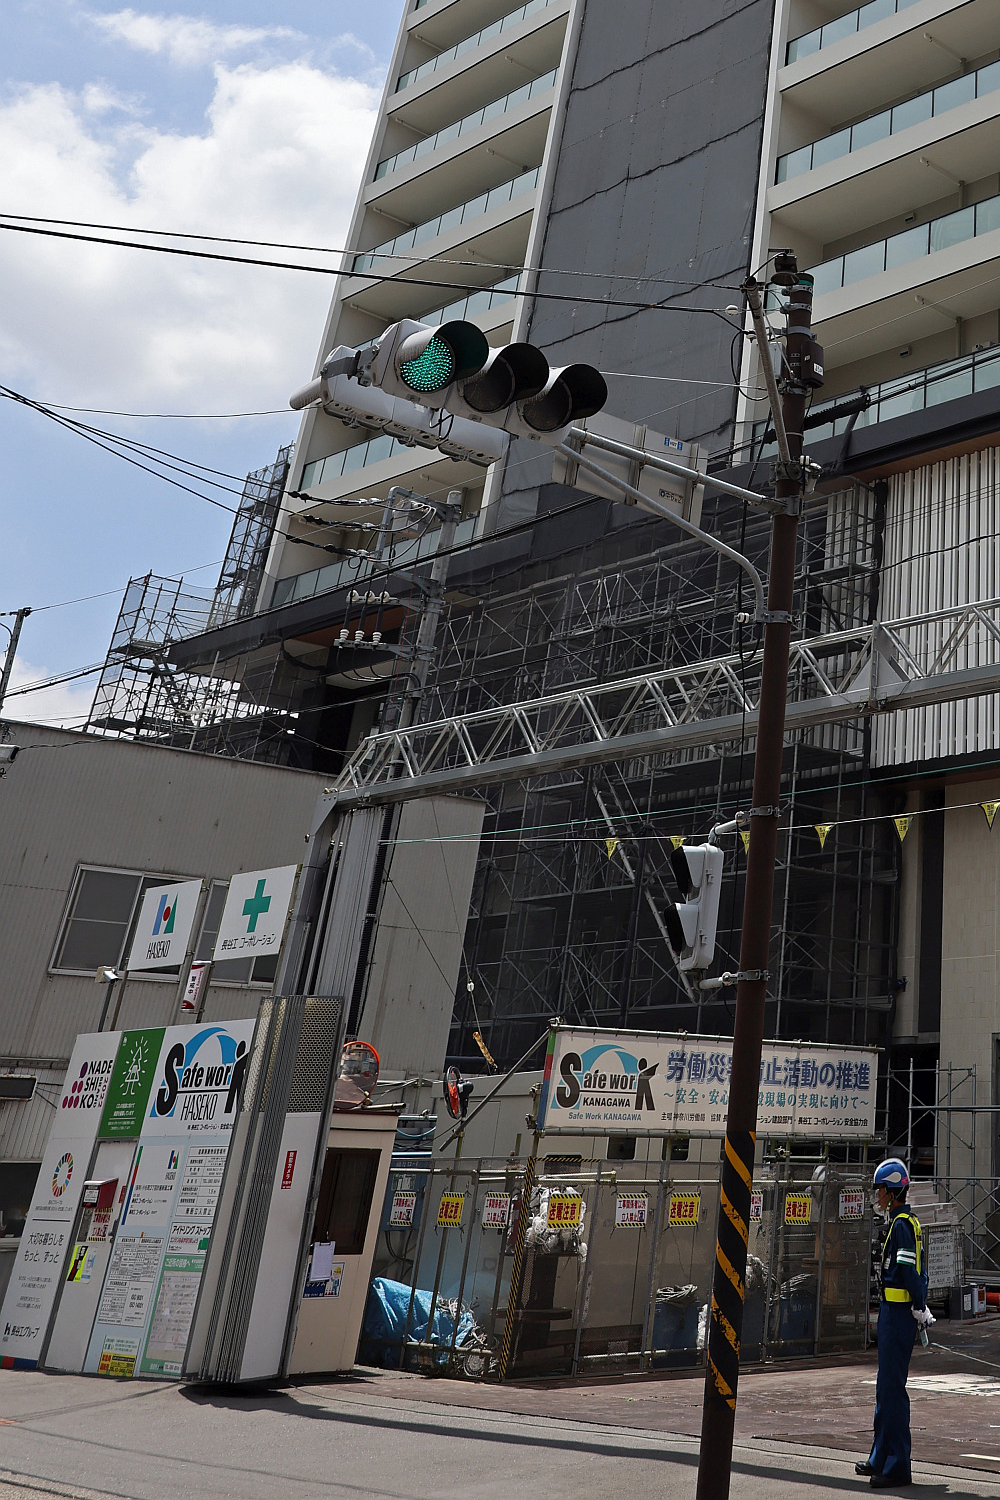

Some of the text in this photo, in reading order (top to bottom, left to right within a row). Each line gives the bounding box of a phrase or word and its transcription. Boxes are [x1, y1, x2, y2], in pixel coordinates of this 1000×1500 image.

[146, 940, 171, 960] HASEKO
[88, 1060, 113, 1075] NADE
[664, 1049, 871, 1091] 労働災止活動の推進
[84, 1077, 100, 1092] SHI
[157, 1043, 205, 1115] Safe
[556, 1052, 607, 1109] Safe
[79, 1094, 94, 1109] KO
[180, 1093, 218, 1121] HASEKO
[582, 1096, 631, 1108] KANAGAWA
[568, 1112, 642, 1122] Safe Work KANAGAWA
[618, 1200, 647, 1209] 工事関係者以外
[27, 1232, 64, 1246] 大切な暮らしを
